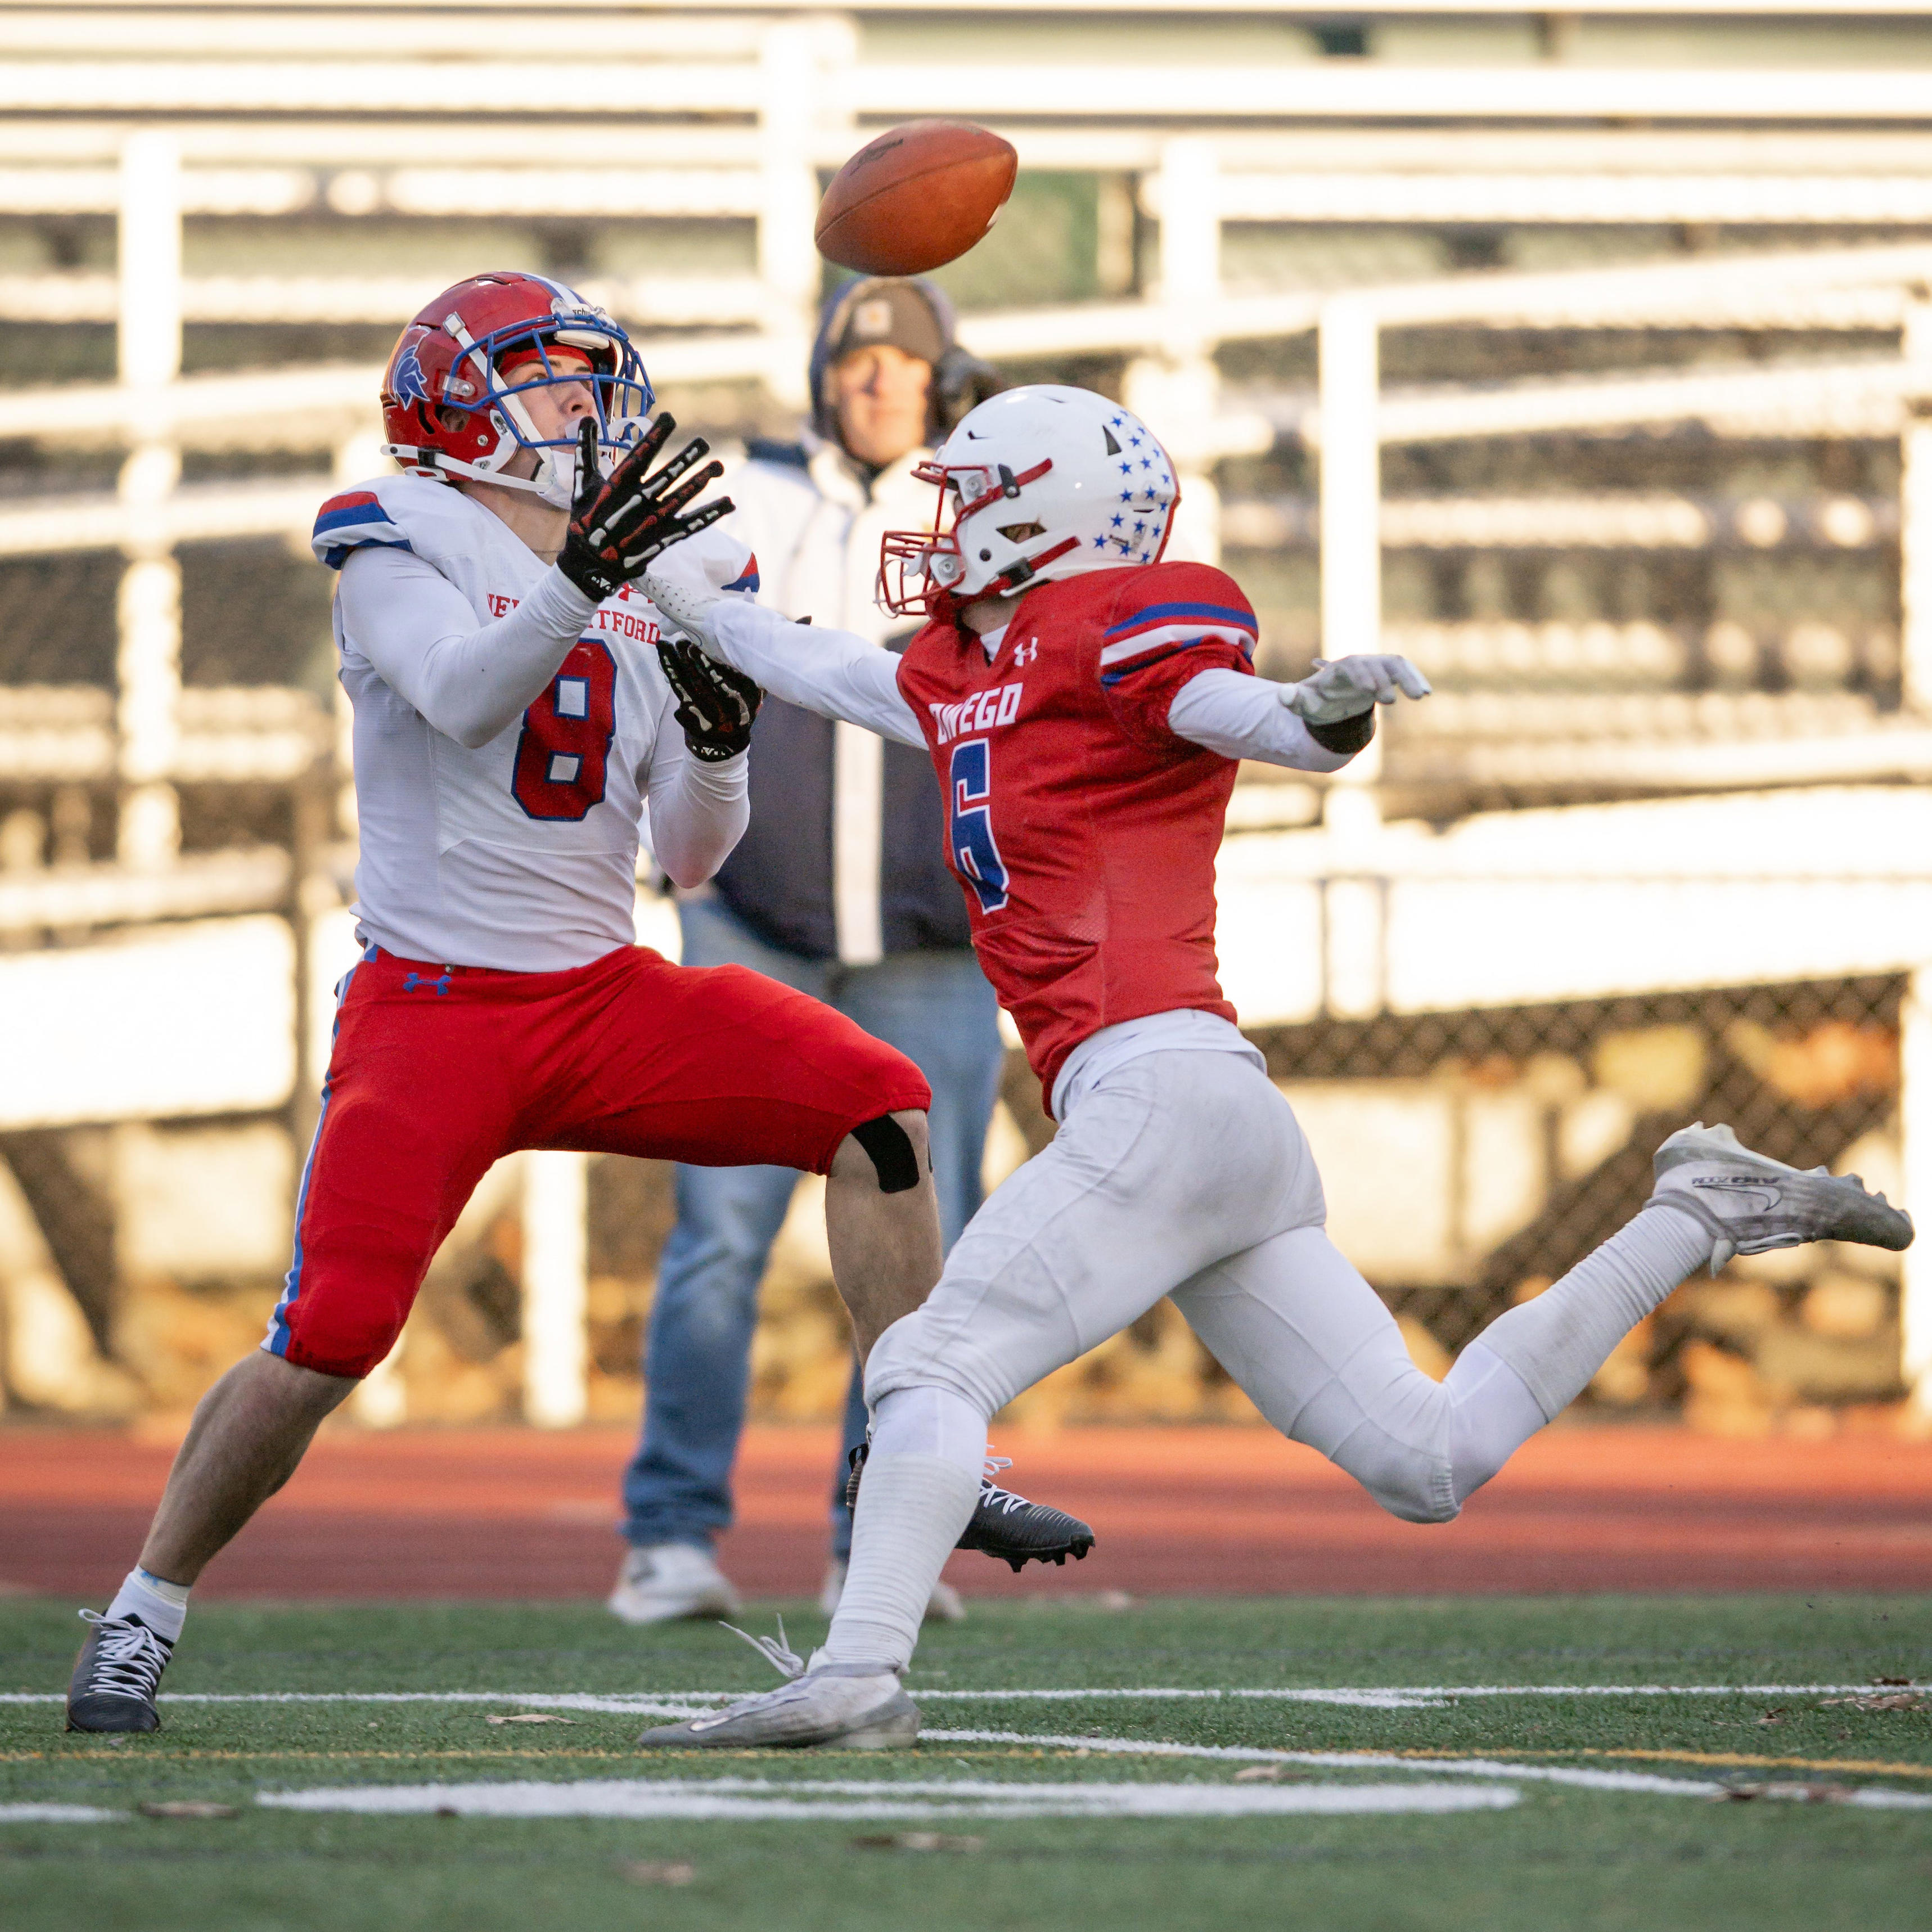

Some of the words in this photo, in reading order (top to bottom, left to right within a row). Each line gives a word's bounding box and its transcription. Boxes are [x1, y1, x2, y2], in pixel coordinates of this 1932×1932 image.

[588, 609, 661, 645] TFORD
[511, 637, 618, 822] 8
[929, 682, 1023, 745] OWEGO
[949, 737, 1009, 915] 6
